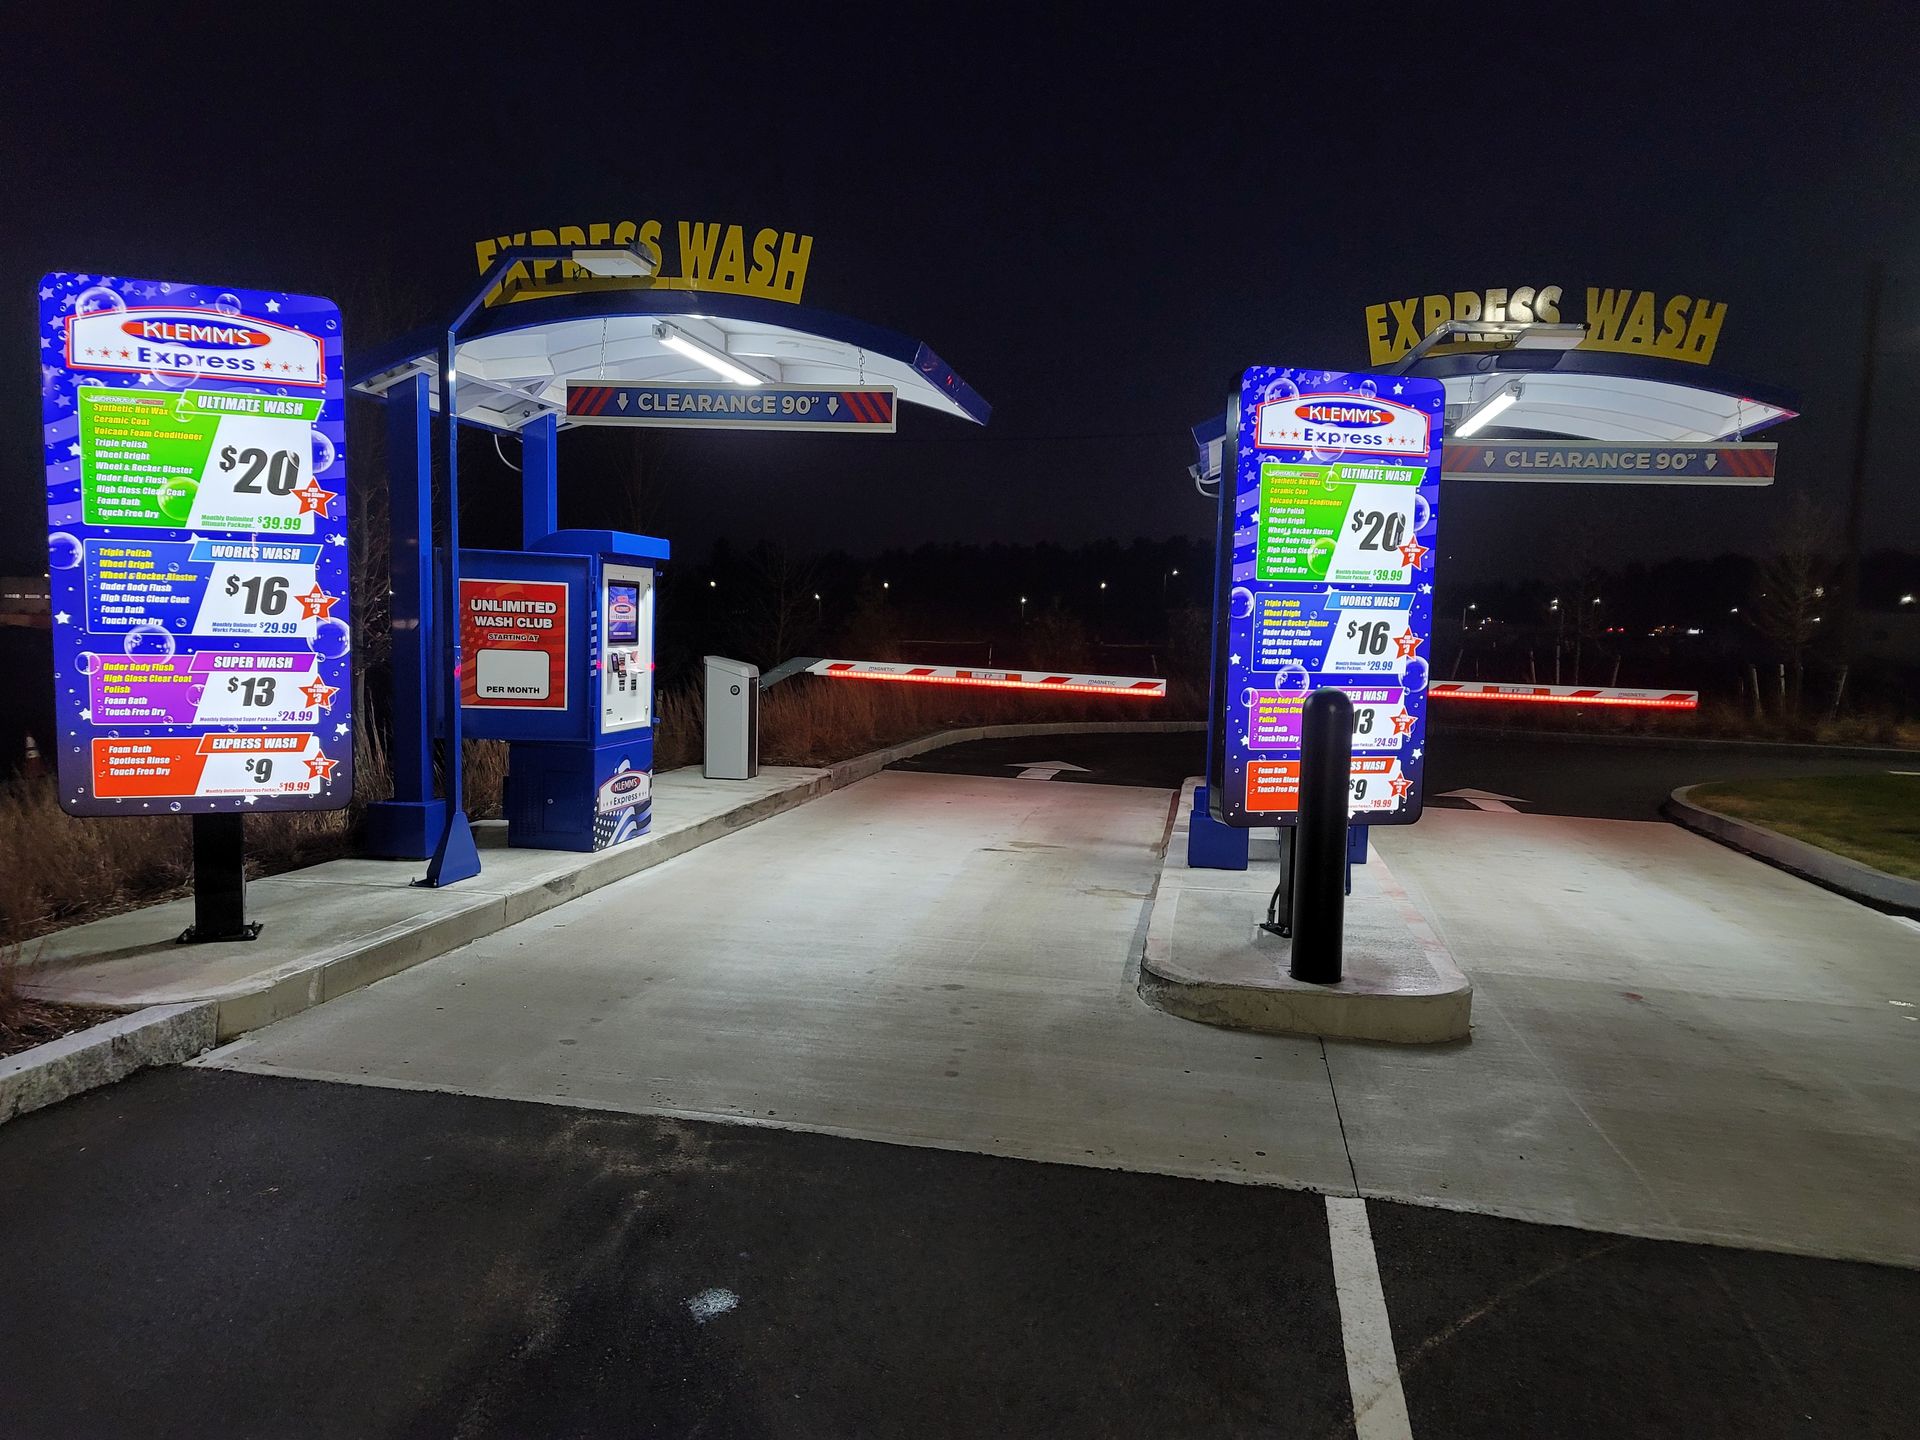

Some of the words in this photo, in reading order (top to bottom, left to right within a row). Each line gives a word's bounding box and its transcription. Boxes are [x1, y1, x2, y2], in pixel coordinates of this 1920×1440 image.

[678, 220, 814, 304] WASH
[1586, 286, 1728, 366] WASH
[142, 320, 251, 346] KLEMM'S
[137, 346, 255, 371] Express
[93, 403, 134, 413] Synthetic
[135, 404, 150, 413] Hot
[151, 406, 169, 415] Wax
[198, 396, 260, 412] ULTIMATE
[264, 400, 304, 416] WASH
[638, 393, 776, 414] CLEARANCE
[93, 415, 129, 424] Ceramic
[130, 417, 150, 426] Coat
[1309, 406, 1382, 424] KLEMM'S
[94, 427, 128, 436] Volcano
[130, 429, 152, 438] Foam
[153, 430, 203, 440] Conditioner
[1304, 428, 1382, 445] Express
[95, 438, 120, 448] Triple
[121, 439, 148, 448] Polish
[95, 450, 122, 458] Wheel
[124, 451, 150, 460] Bright
[1504, 450, 1649, 469] CLEARANCE
[95, 462, 122, 470] Wheel
[124, 463, 130, 471] &
[132, 463, 161, 472] Rocker
[162, 465, 193, 474] Blaster
[219, 445, 300, 496] $20
[96, 473, 122, 482] Under
[123, 474, 144, 484] Body
[145, 475, 168, 484] Flush
[1341, 468, 1384, 480] ULTIMATE
[1385, 470, 1412, 482] WASH
[96, 485, 116, 494] High
[118, 486, 141, 494] Gloss
[142, 487, 165, 496] Clear
[166, 488, 186, 497] Coat
[97, 497, 119, 505] Foam
[121, 497, 141, 506] Bath
[98, 508, 124, 517] Touch
[125, 509, 143, 518] Free
[145, 510, 160, 519] Dry
[258, 516, 302, 530] $39.99
[1351, 509, 1406, 552] $20
[99, 548, 124, 556] Triple
[126, 549, 152, 557] Polish
[212, 545, 259, 559] WORKS
[262, 547, 300, 560] WASH
[100, 560, 127, 568] Wheel
[128, 560, 154, 569] Bright
[100, 571, 127, 579] Wheel
[136, 572, 165, 580] Rocker
[166, 573, 198, 581] Blaster
[1373, 570, 1403, 581] $39.99
[100, 582, 126, 590] Under
[127, 583, 148, 592] Body
[149, 583, 172, 591] Flush
[100, 594, 120, 602] High
[121, 594, 145, 602] Gloss
[146, 595, 169, 603] Clear
[170, 595, 190, 603] Coat
[225, 574, 289, 615] $16
[470, 599, 557, 614] UNLIMITED
[1340, 596, 1372, 606] WORKS
[1374, 596, 1400, 607] WASH
[101, 605, 123, 613] Foam
[125, 605, 145, 614] Bath
[102, 616, 127, 625] Touch
[128, 617, 147, 625] Free
[148, 617, 164, 626] Dry
[474, 616, 513, 627] WASH
[516, 618, 553, 628] CLUB
[259, 622, 297, 634] $29.99
[488, 633, 526, 641] STARTING
[528, 634, 540, 642] AT
[1347, 620, 1390, 655] $16
[103, 663, 128, 671] Under
[130, 664, 150, 672] Body
[152, 664, 174, 672] Flush
[214, 656, 254, 668] SUPER
[256, 657, 294, 668] WASH
[1367, 660, 1393, 671] $29.99
[104, 675, 123, 683] High
[124, 675, 148, 683] Gloss
[149, 675, 172, 683] Clear
[173, 675, 192, 683] Coat
[104, 686, 130, 694] Polish
[227, 676, 276, 707] $13
[1344, 691, 1361, 701] PER
[1363, 691, 1388, 701] WASH
[104, 697, 126, 705] Foam
[128, 697, 148, 705] Bath
[105, 708, 130, 716] Touch
[132, 708, 150, 716] Free
[151, 708, 166, 717] Dry
[278, 710, 313, 721] $24.99
[1354, 709, 1375, 734] 13
[212, 738, 262, 749] EXPRESS
[264, 737, 298, 748] WASH
[1374, 738, 1398, 747] $24.99
[109, 757, 145, 765] Spotless
[1363, 761, 1386, 770] WASH
[110, 768, 135, 776] Touch
[136, 768, 154, 776] Free
[156, 768, 171, 776] Dry
[245, 758, 273, 783] $9
[280, 782, 310, 792] $19.99
[1349, 779, 1367, 800] $9
[614, 793, 638, 805] Express
